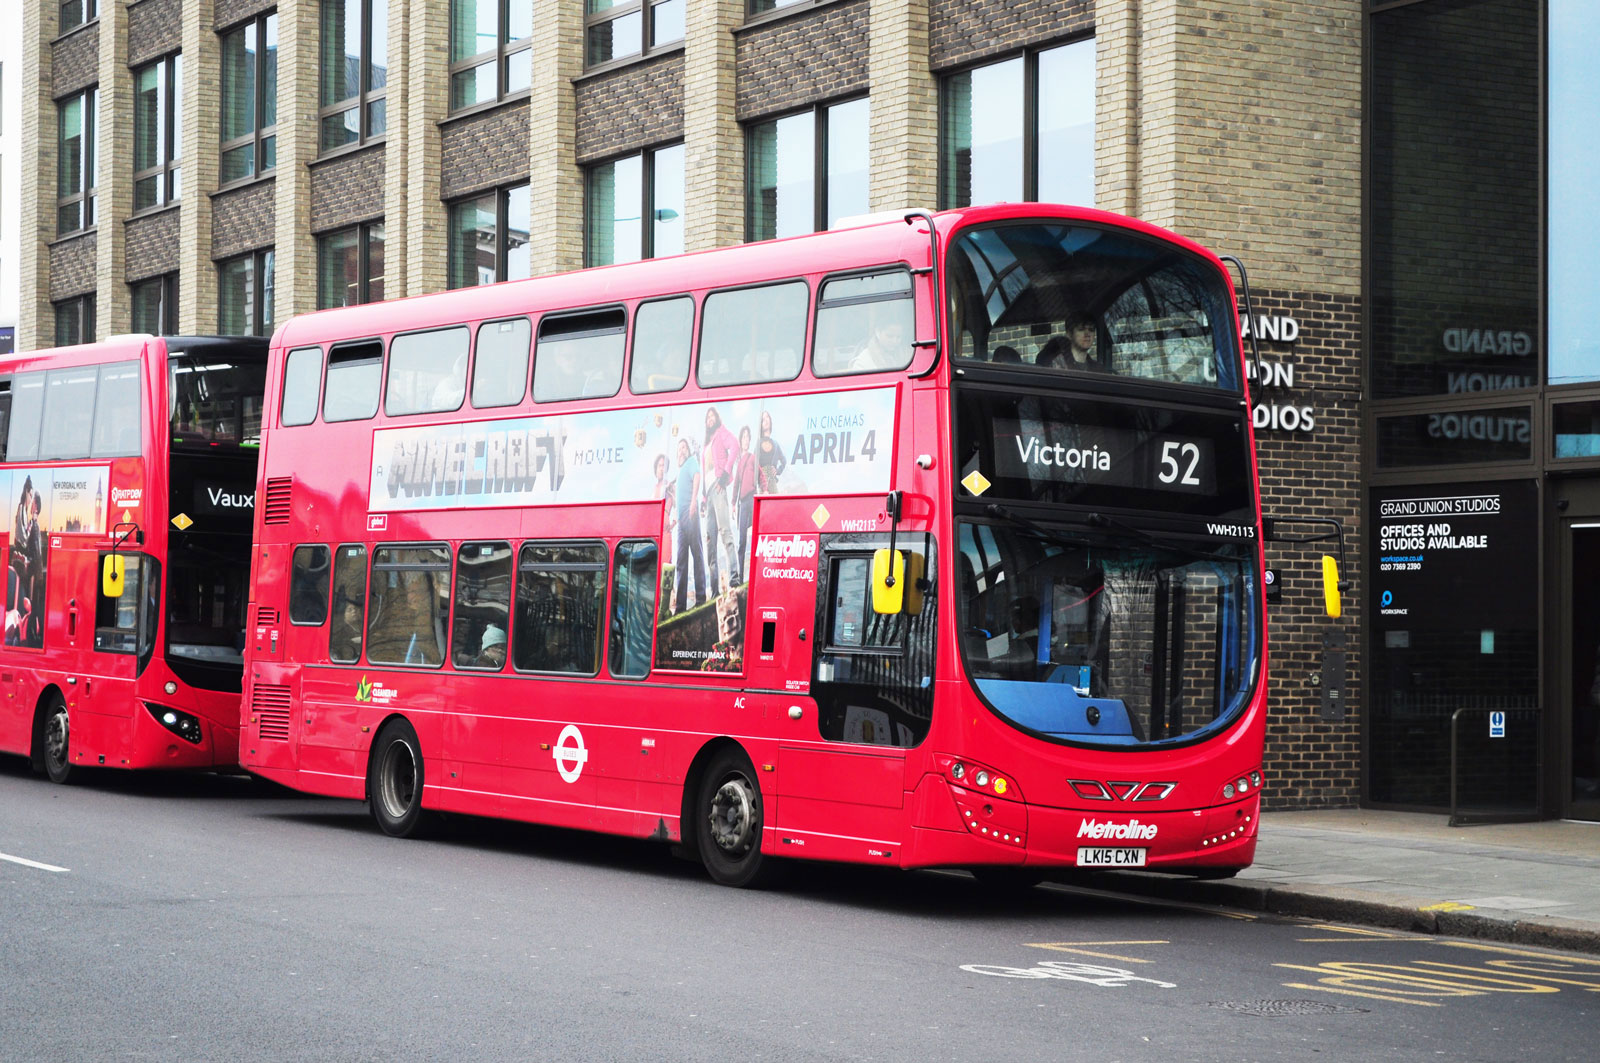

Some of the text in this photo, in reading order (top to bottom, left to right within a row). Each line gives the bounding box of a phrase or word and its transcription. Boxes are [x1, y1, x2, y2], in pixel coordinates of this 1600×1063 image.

[1241, 315, 1299, 341] AND
[807, 413, 865, 430] IN CINEMAS
[1252, 404, 1315, 432] DIOS
[790, 429, 877, 465] APRIL 4
[376, 428, 624, 499] A MINECRAFT MOVIE
[1015, 435, 1200, 485] Victoria 52
[207, 487, 257, 508] Vaux
[1380, 498, 1501, 515] GRAND UNION STUDIOS
[841, 519, 877, 532] VWH2113
[1206, 523, 1254, 538] VWH2113
[1380, 523, 1451, 538] OFFICES AND
[755, 534, 817, 559] Metroline
[1380, 535, 1488, 551] STUDIOS AVAILABLE
[1380, 554, 1424, 563] workspace.co.uk
[1380, 563, 1392, 571] 020
[672, 650, 697, 659] EXPERIENCE
[708, 651, 726, 660] IMAX
[734, 696, 746, 709] AC
[1076, 817, 1158, 840] Metroline
[1084, 849, 1139, 864] LK15 CXN
